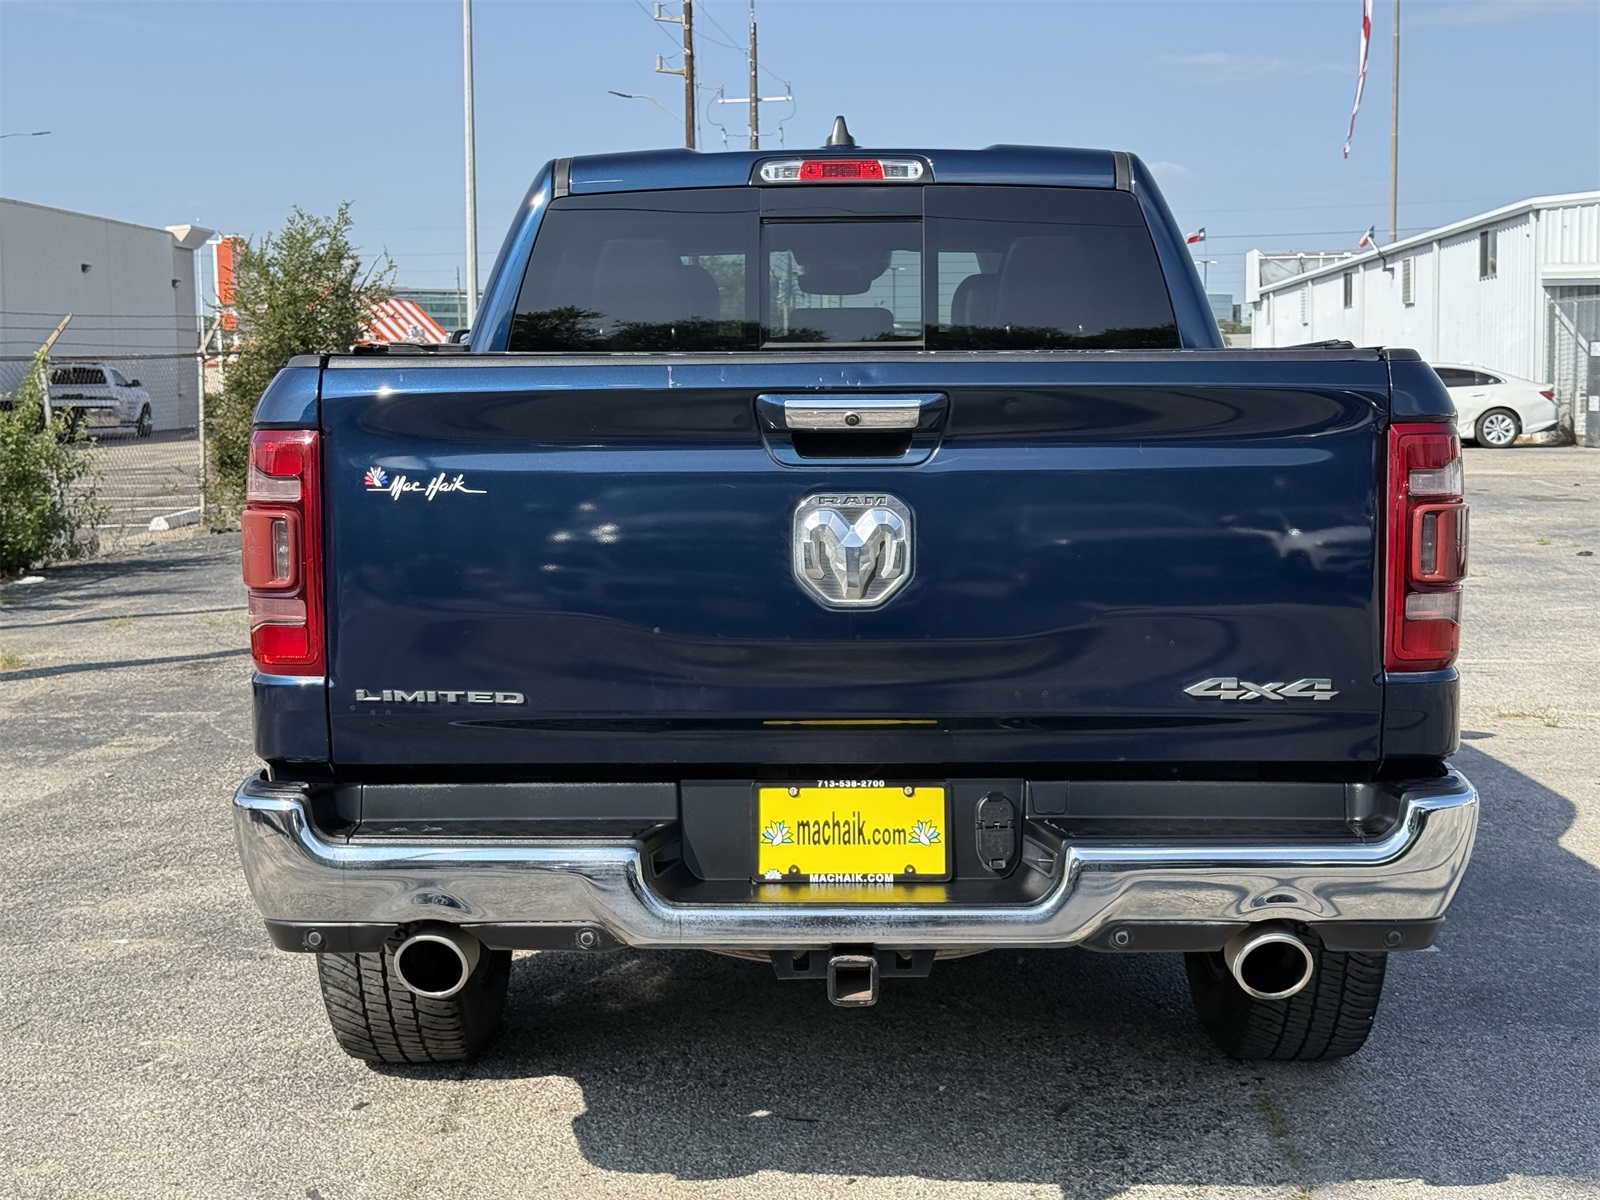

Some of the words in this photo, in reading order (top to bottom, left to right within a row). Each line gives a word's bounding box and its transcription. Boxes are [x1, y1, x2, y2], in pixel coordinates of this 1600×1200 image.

[388, 475, 426, 501] Mac
[425, 472, 487, 501] Haik
[818, 496, 888, 506] RAM
[355, 689, 525, 704] LIMITED
[796, 811, 907, 846] machaik.com
[809, 874, 894, 883] MACHAIK.COM
